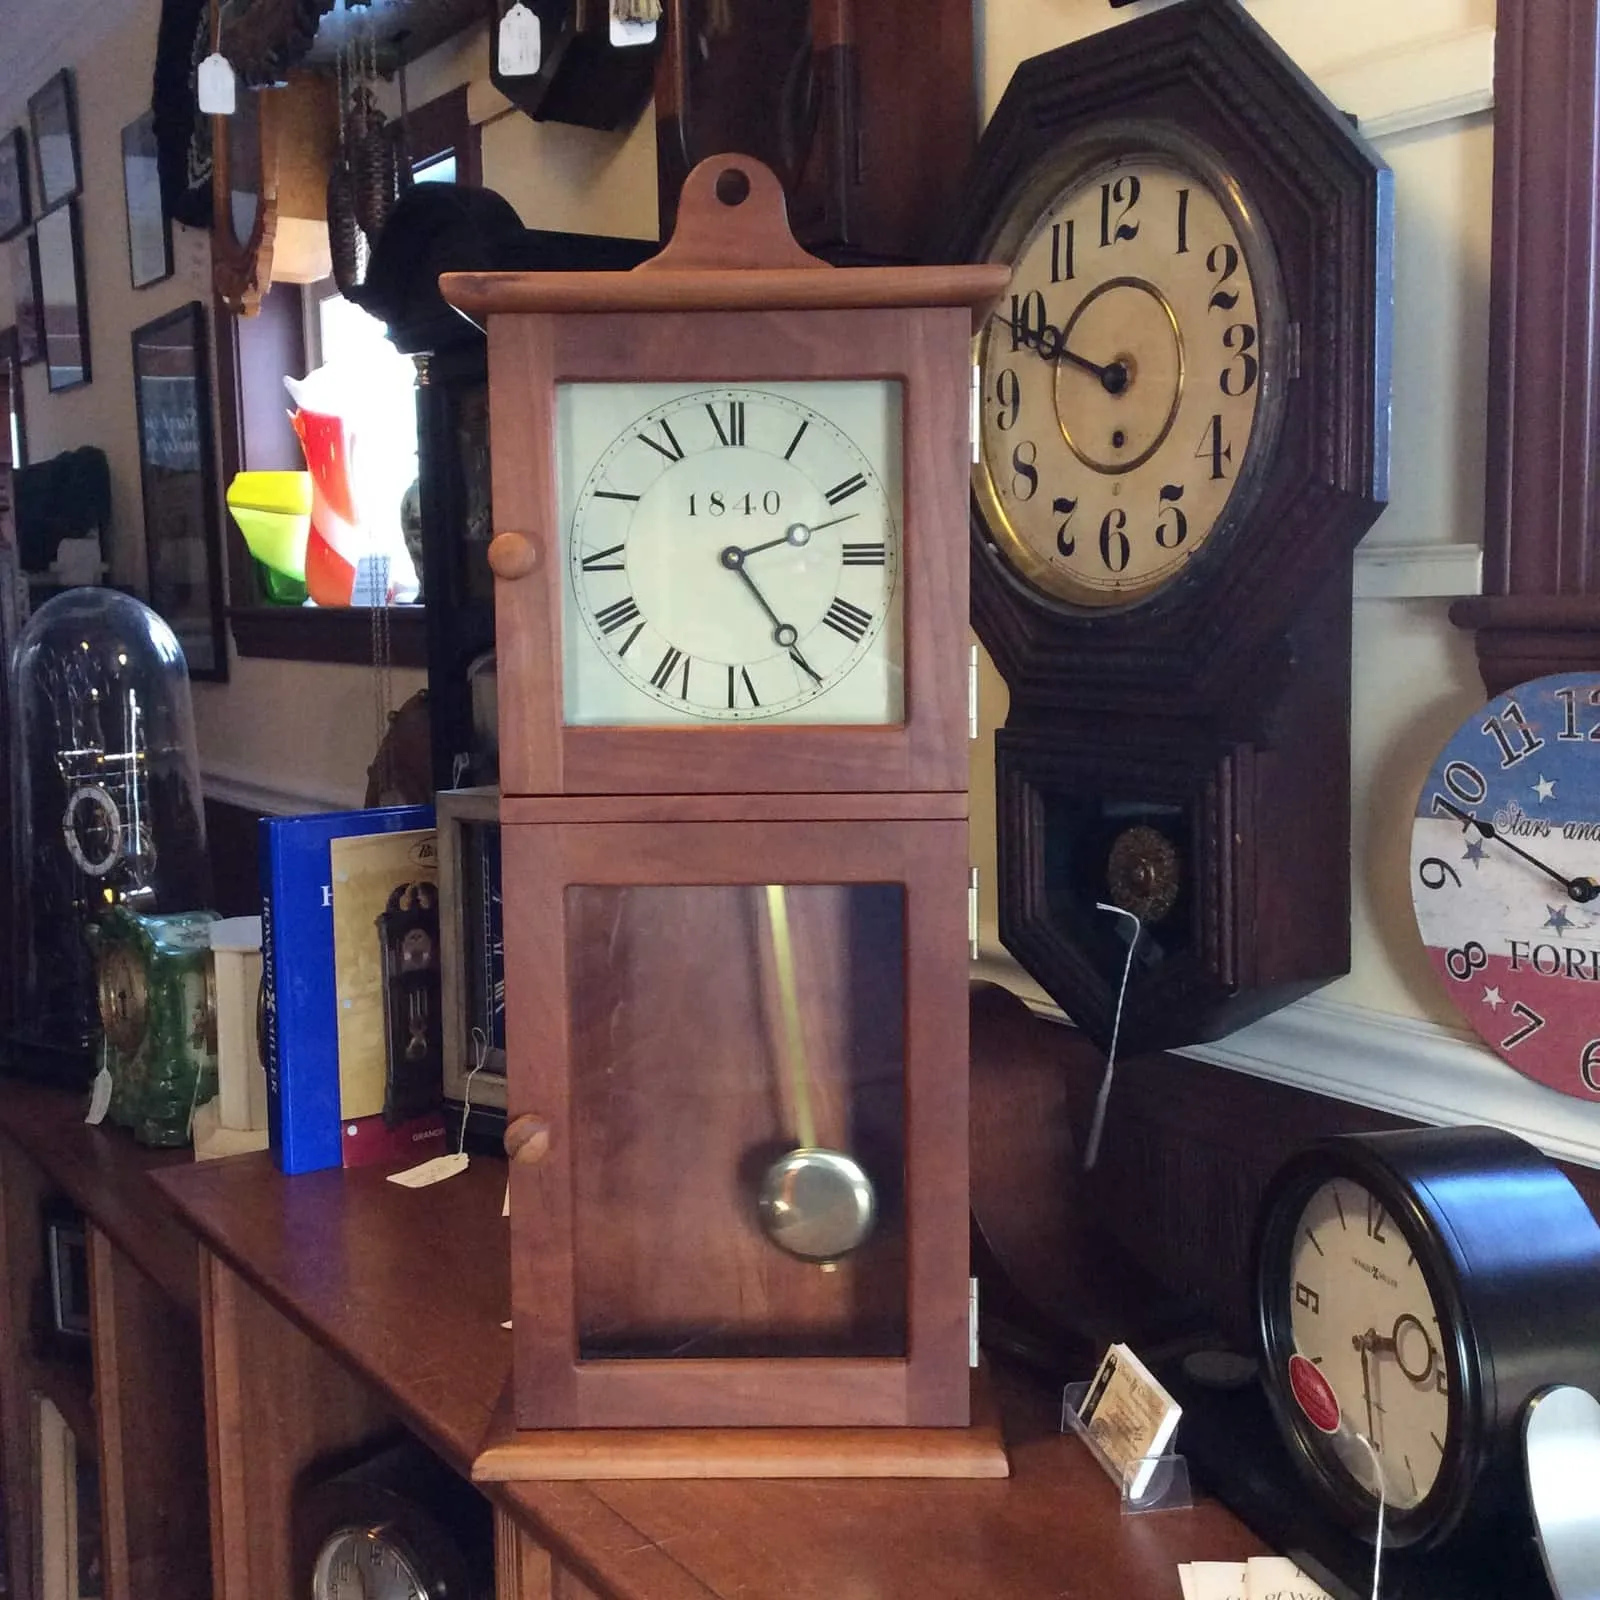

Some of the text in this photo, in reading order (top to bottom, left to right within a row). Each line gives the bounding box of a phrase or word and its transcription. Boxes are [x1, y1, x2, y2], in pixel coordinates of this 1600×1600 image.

[1099, 175, 1141, 248] 12
[1175, 189, 1189, 254] 1
[1050, 219, 1074, 283] 11
[1206, 244, 1238, 313] 2
[1220, 324, 1258, 396] 3
[706, 401, 745, 447] XII
[996, 368, 1020, 431] 9
[1011, 441, 1038, 500] 8
[1195, 414, 1231, 480] 4
[688, 490, 781, 517] 1840
[825, 472, 867, 506] II
[1155, 484, 1187, 549] 5
[842, 542, 886, 566] III
[1052, 497, 1078, 557] 7
[1099, 508, 1131, 572] 6
[595, 596, 648, 657] VIII
[650, 646, 691, 700] VII
[728, 665, 761, 709] VI
[1482, 703, 1545, 769] 11
[1494, 801, 1552, 838] Stars
[1419, 856, 1462, 889] 9
[1447, 940, 1488, 981] 8
[262, 896, 278, 1095] HOWARD MILLER
[1501, 1002, 1545, 1050] 7
[1295, 1281, 1320, 1315] 9
